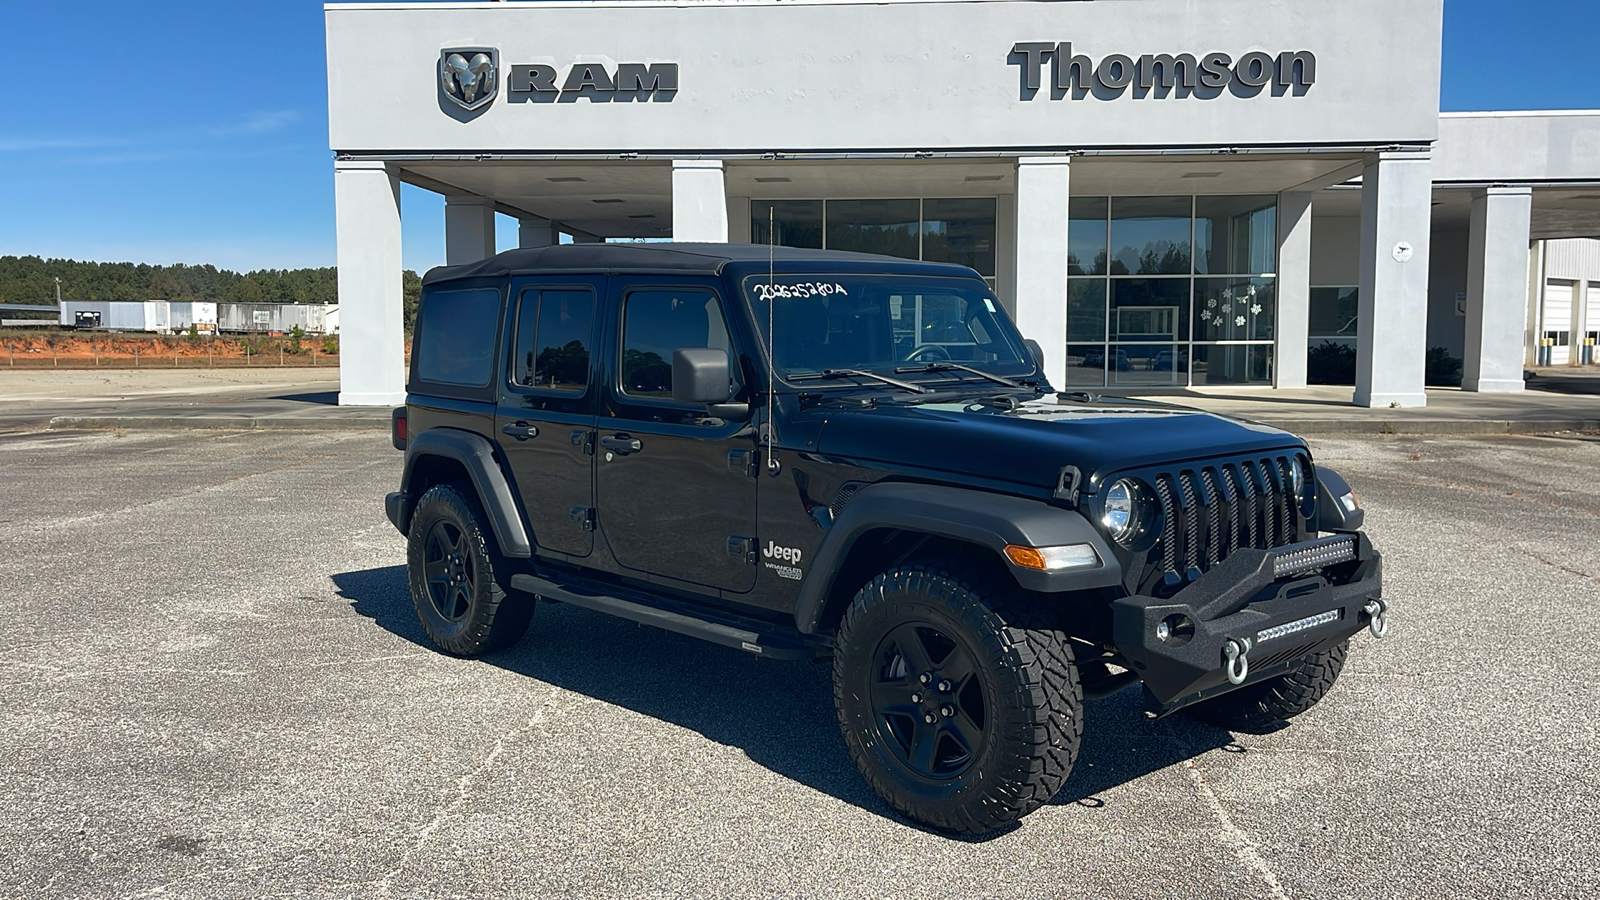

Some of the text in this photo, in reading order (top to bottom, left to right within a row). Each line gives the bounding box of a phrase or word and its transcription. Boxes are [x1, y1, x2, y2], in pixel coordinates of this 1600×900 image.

[509, 63, 679, 94] RAM
[1011, 41, 1316, 92] Thomson
[763, 540, 802, 565] Jeep
